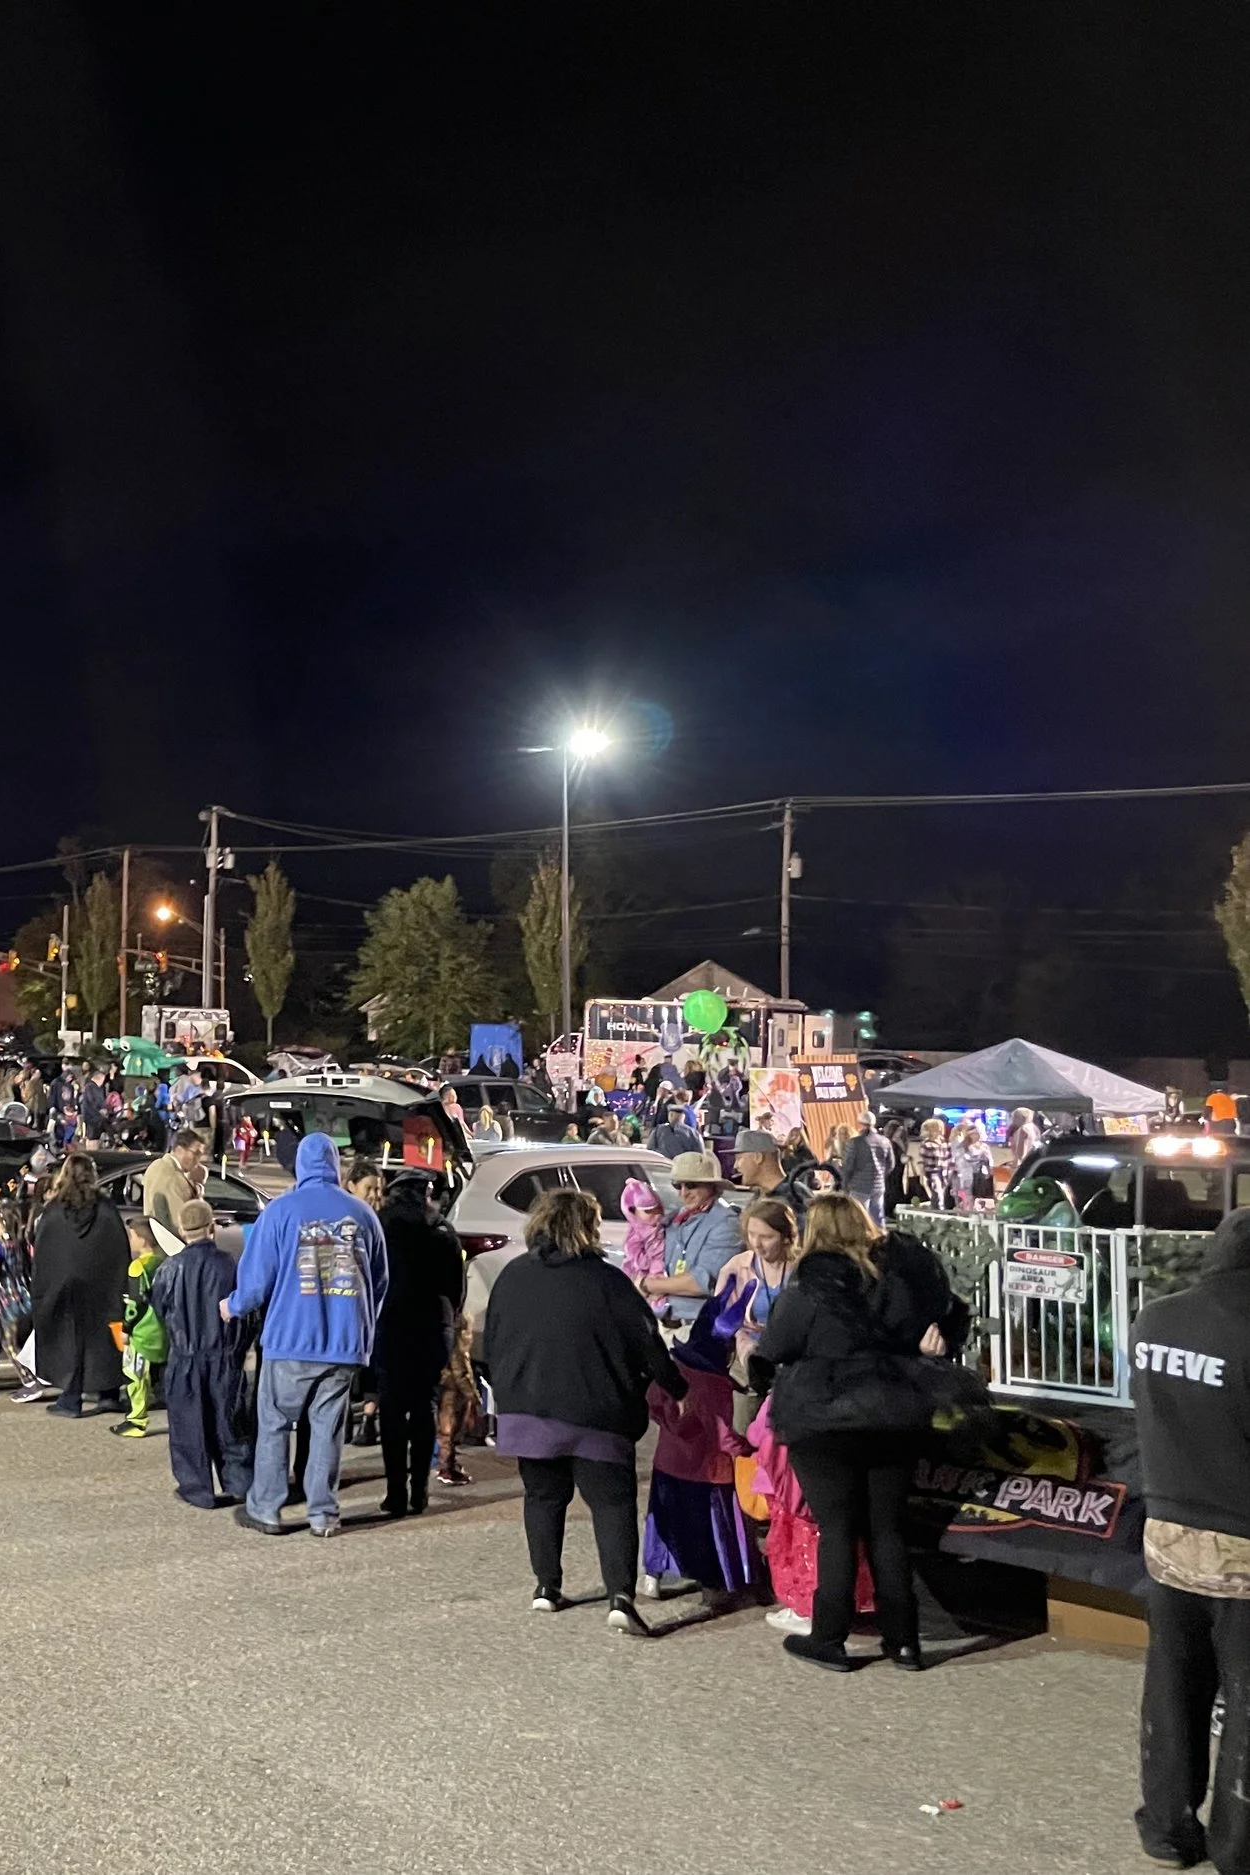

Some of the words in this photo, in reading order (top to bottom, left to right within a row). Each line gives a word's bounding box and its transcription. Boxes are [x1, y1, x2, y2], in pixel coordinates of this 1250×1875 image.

[1025, 1252, 1065, 1264] DANGER
[1009, 1265, 1057, 1277] DINOSAUR
[1020, 1274, 1045, 1284] AREA
[1008, 1282, 1032, 1291] KEEP
[1035, 1285, 1056, 1294] OUT
[1135, 1341, 1225, 1387] STEVE
[993, 1475, 1115, 1526] PARK
